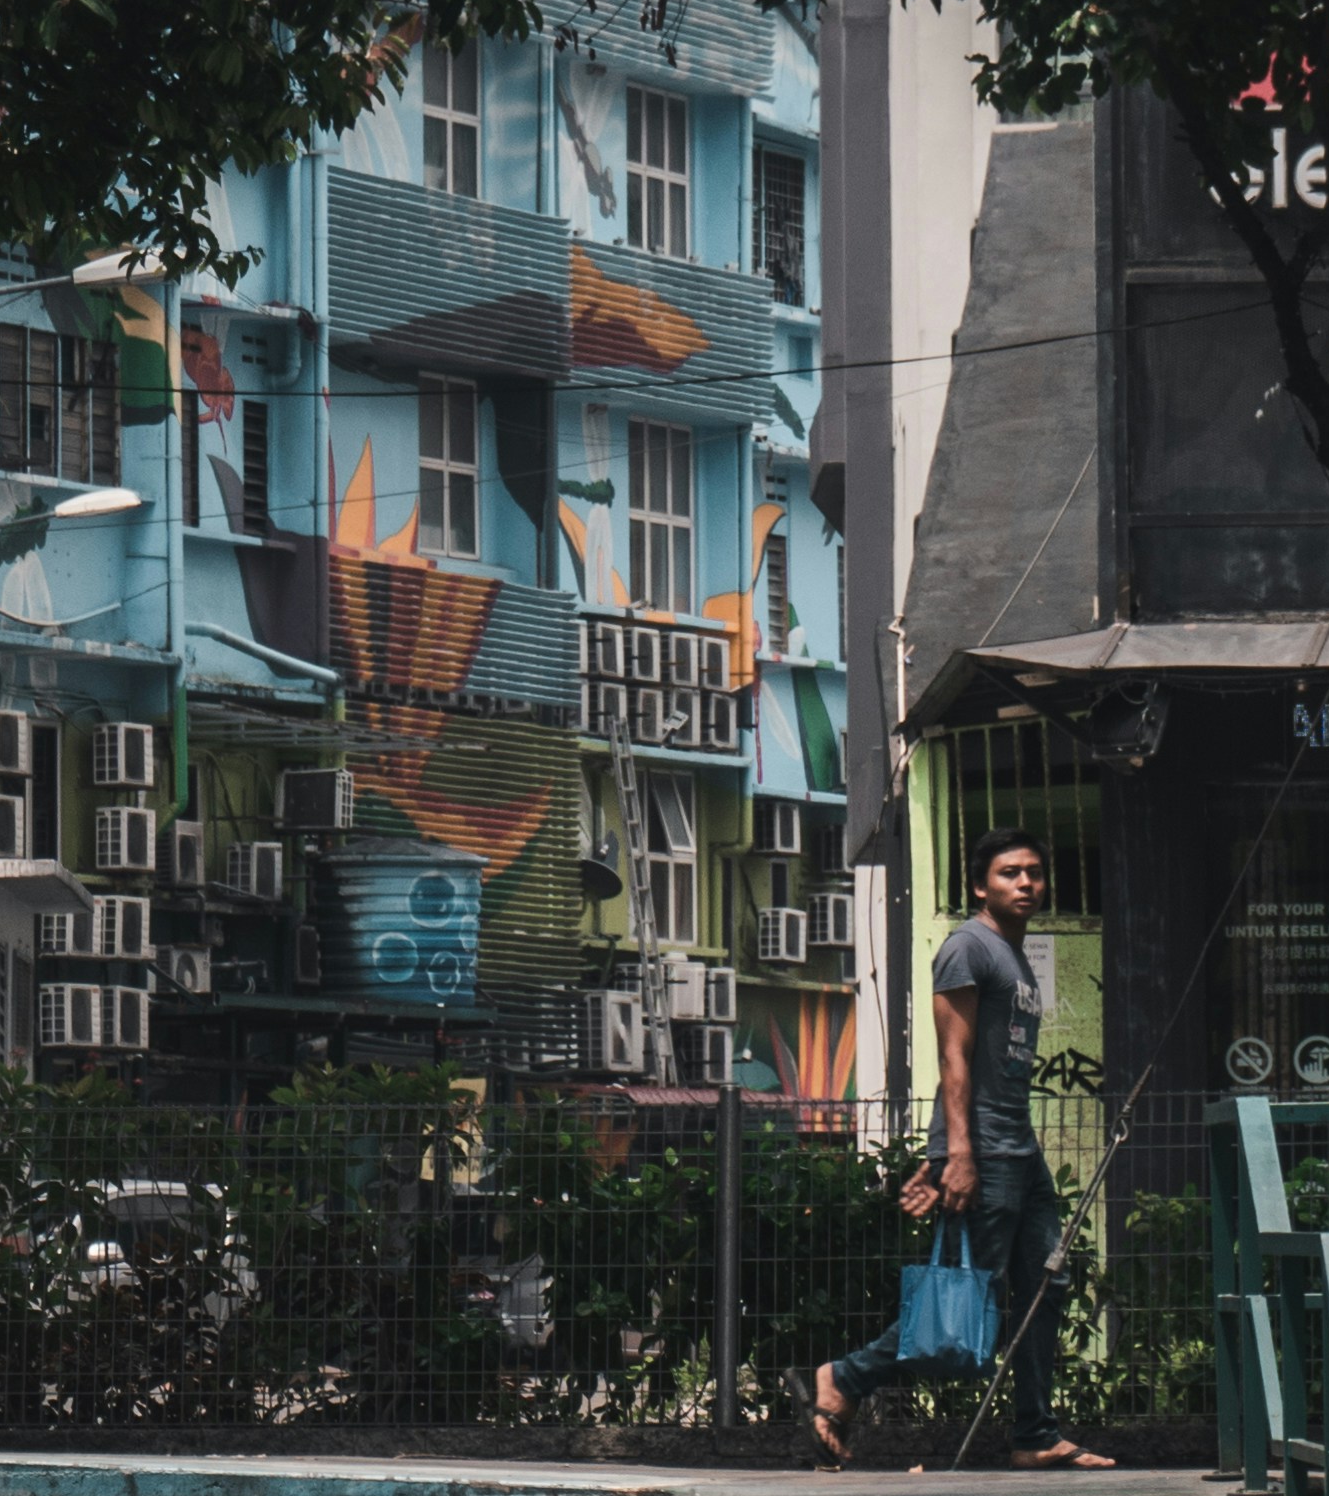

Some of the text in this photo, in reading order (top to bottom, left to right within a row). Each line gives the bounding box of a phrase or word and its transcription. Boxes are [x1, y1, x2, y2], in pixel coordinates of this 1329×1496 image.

[1247, 902, 1279, 916] FOR
[1283, 902, 1325, 916] YOUR
[1225, 925, 1276, 939] UNTUK
